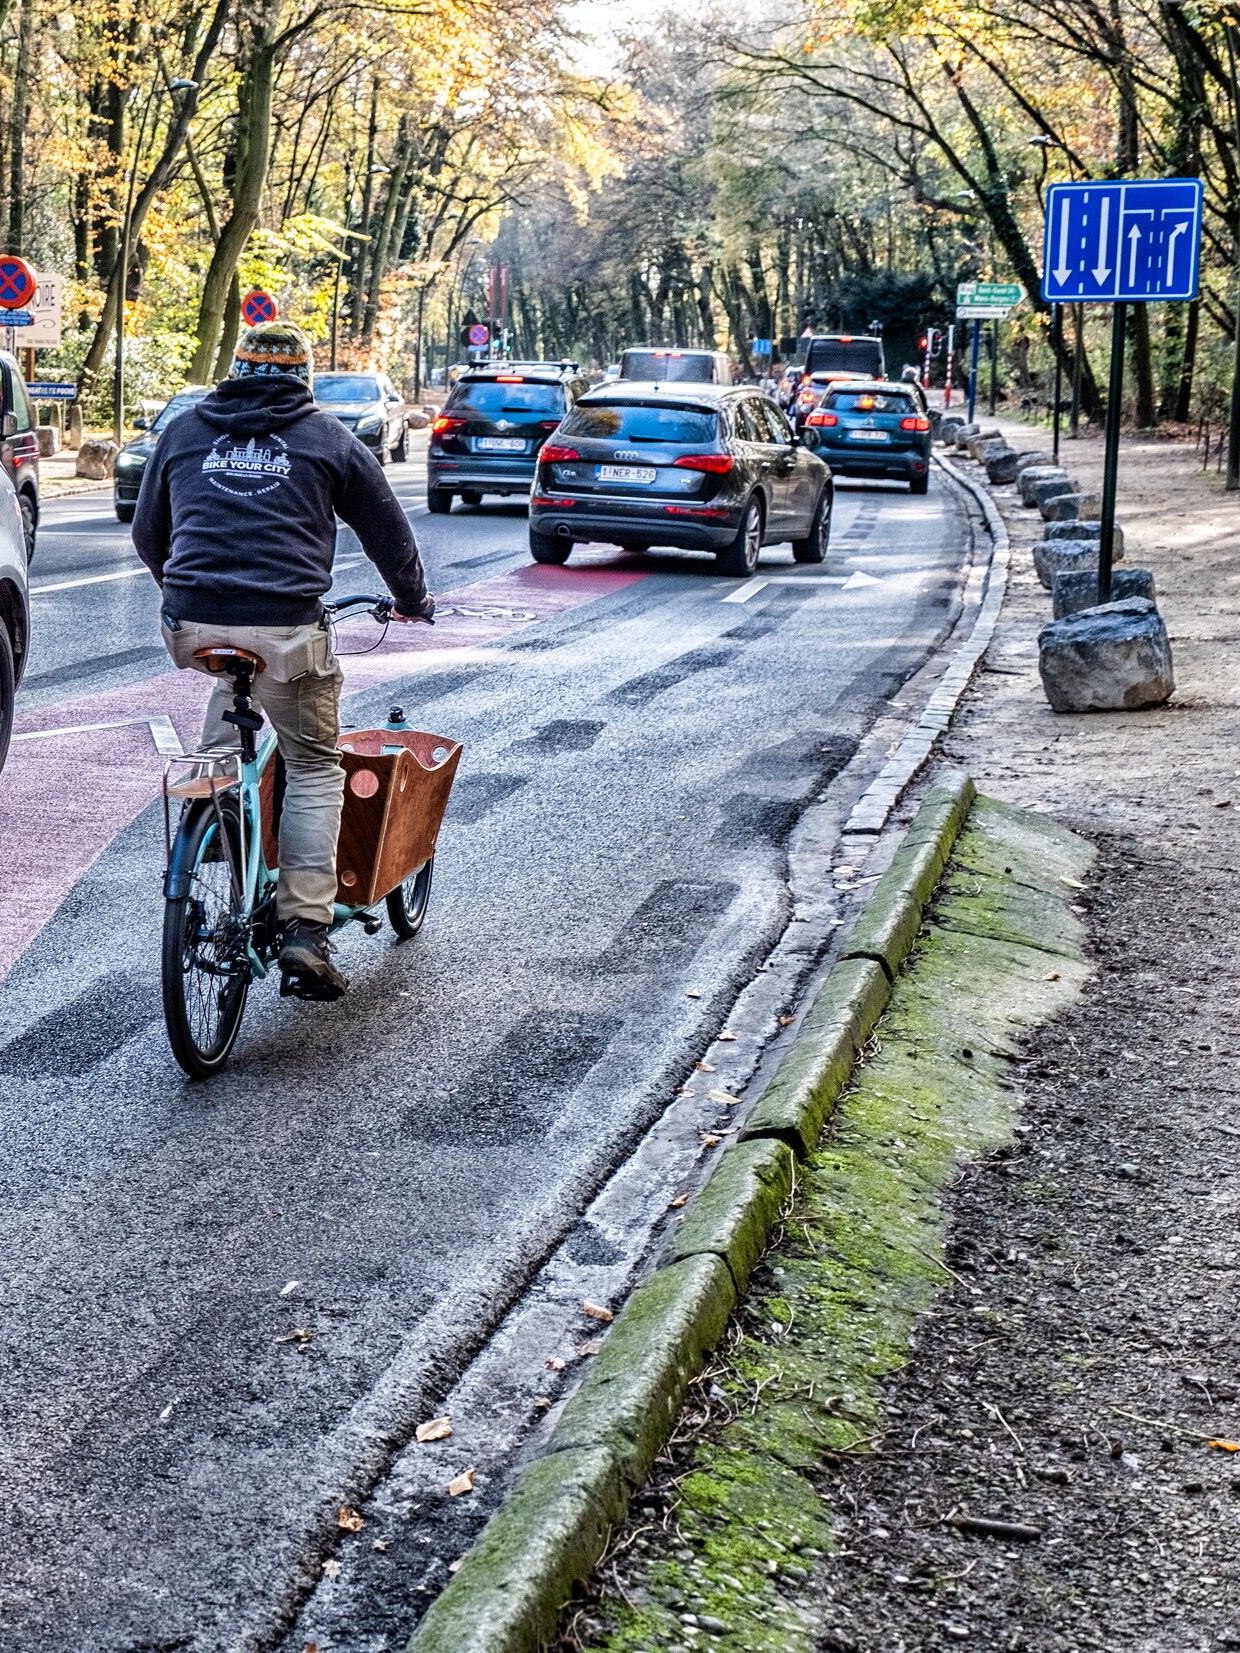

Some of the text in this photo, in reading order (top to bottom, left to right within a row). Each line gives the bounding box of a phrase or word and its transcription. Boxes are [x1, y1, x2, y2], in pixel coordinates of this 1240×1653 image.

[202, 460, 291, 475] BIKE YOUR CITY
[208, 477, 281, 497] MAINTENANCE REPAIR
